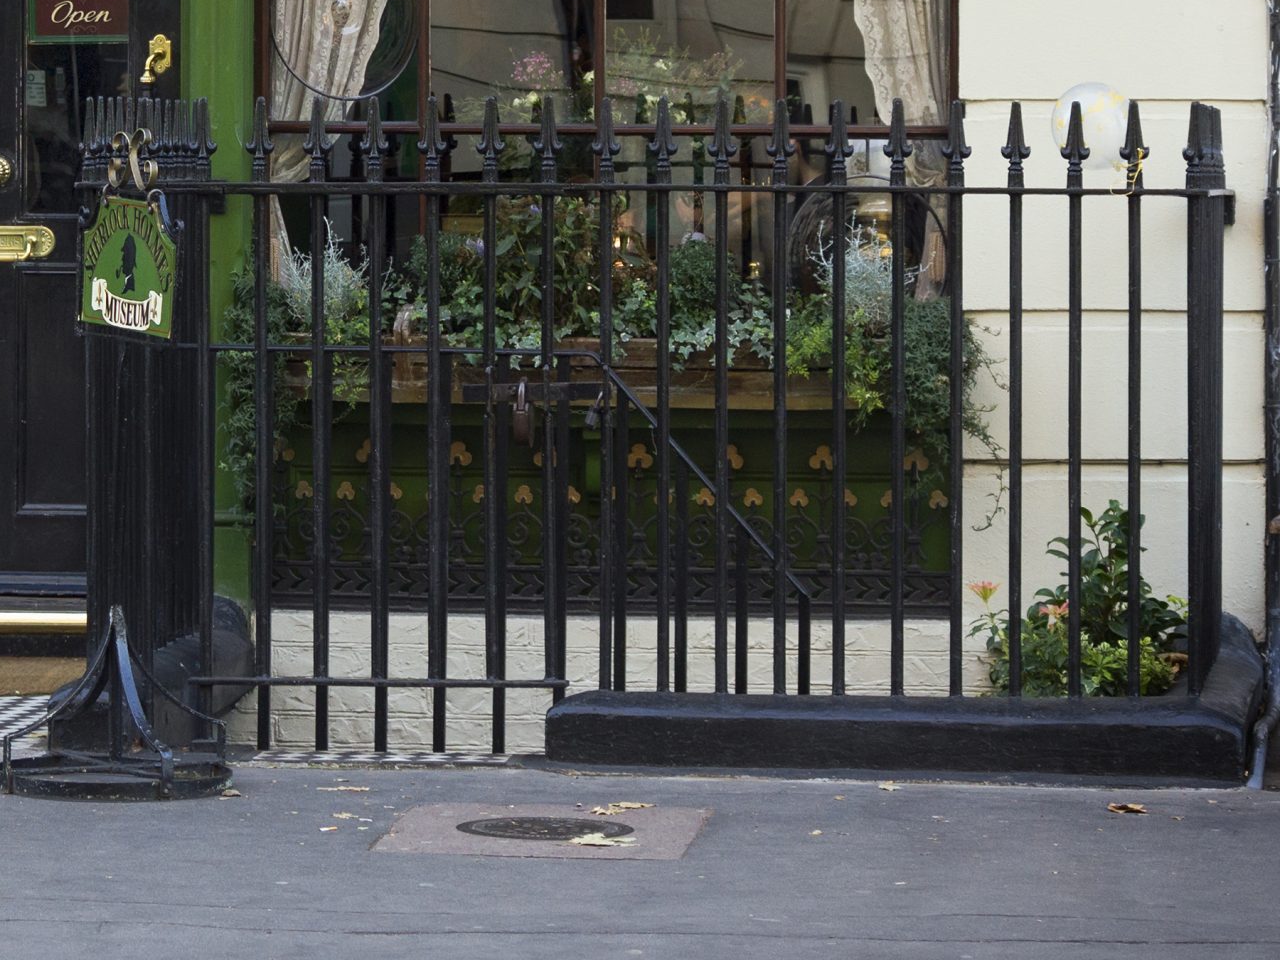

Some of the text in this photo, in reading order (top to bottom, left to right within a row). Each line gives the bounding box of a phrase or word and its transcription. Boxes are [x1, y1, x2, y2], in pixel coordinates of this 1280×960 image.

[51, 0, 113, 28] Open
[85, 204, 173, 292] SHERLOCK HOLMES
[104, 291, 151, 327] MUSEUM
